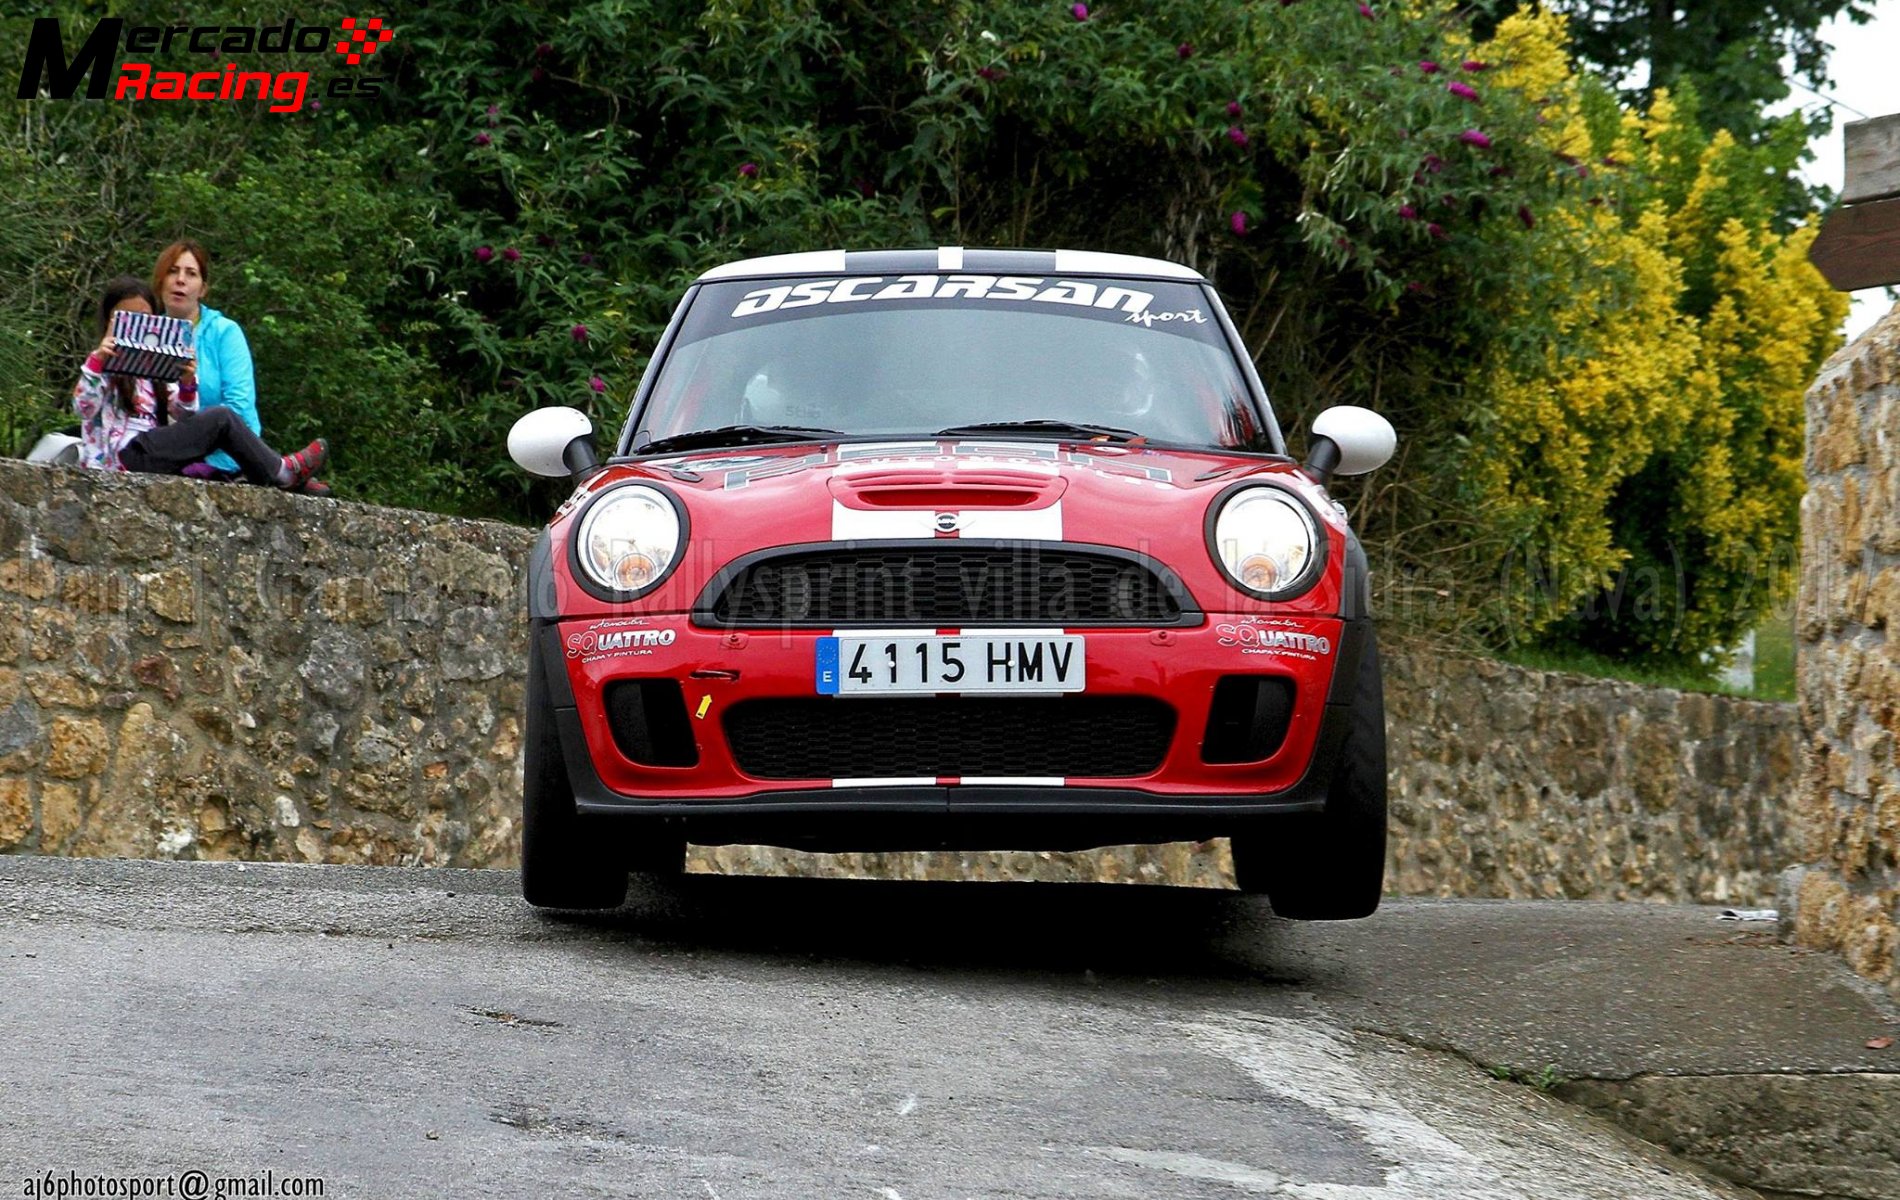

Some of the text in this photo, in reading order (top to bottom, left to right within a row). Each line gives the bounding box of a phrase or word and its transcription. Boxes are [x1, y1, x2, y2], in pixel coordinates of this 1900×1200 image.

[1125, 308, 1208, 327] sport
[566, 629, 676, 659] SQUATTRO
[848, 641, 1074, 684] 4115 HMV
[822, 671, 833, 682] E
